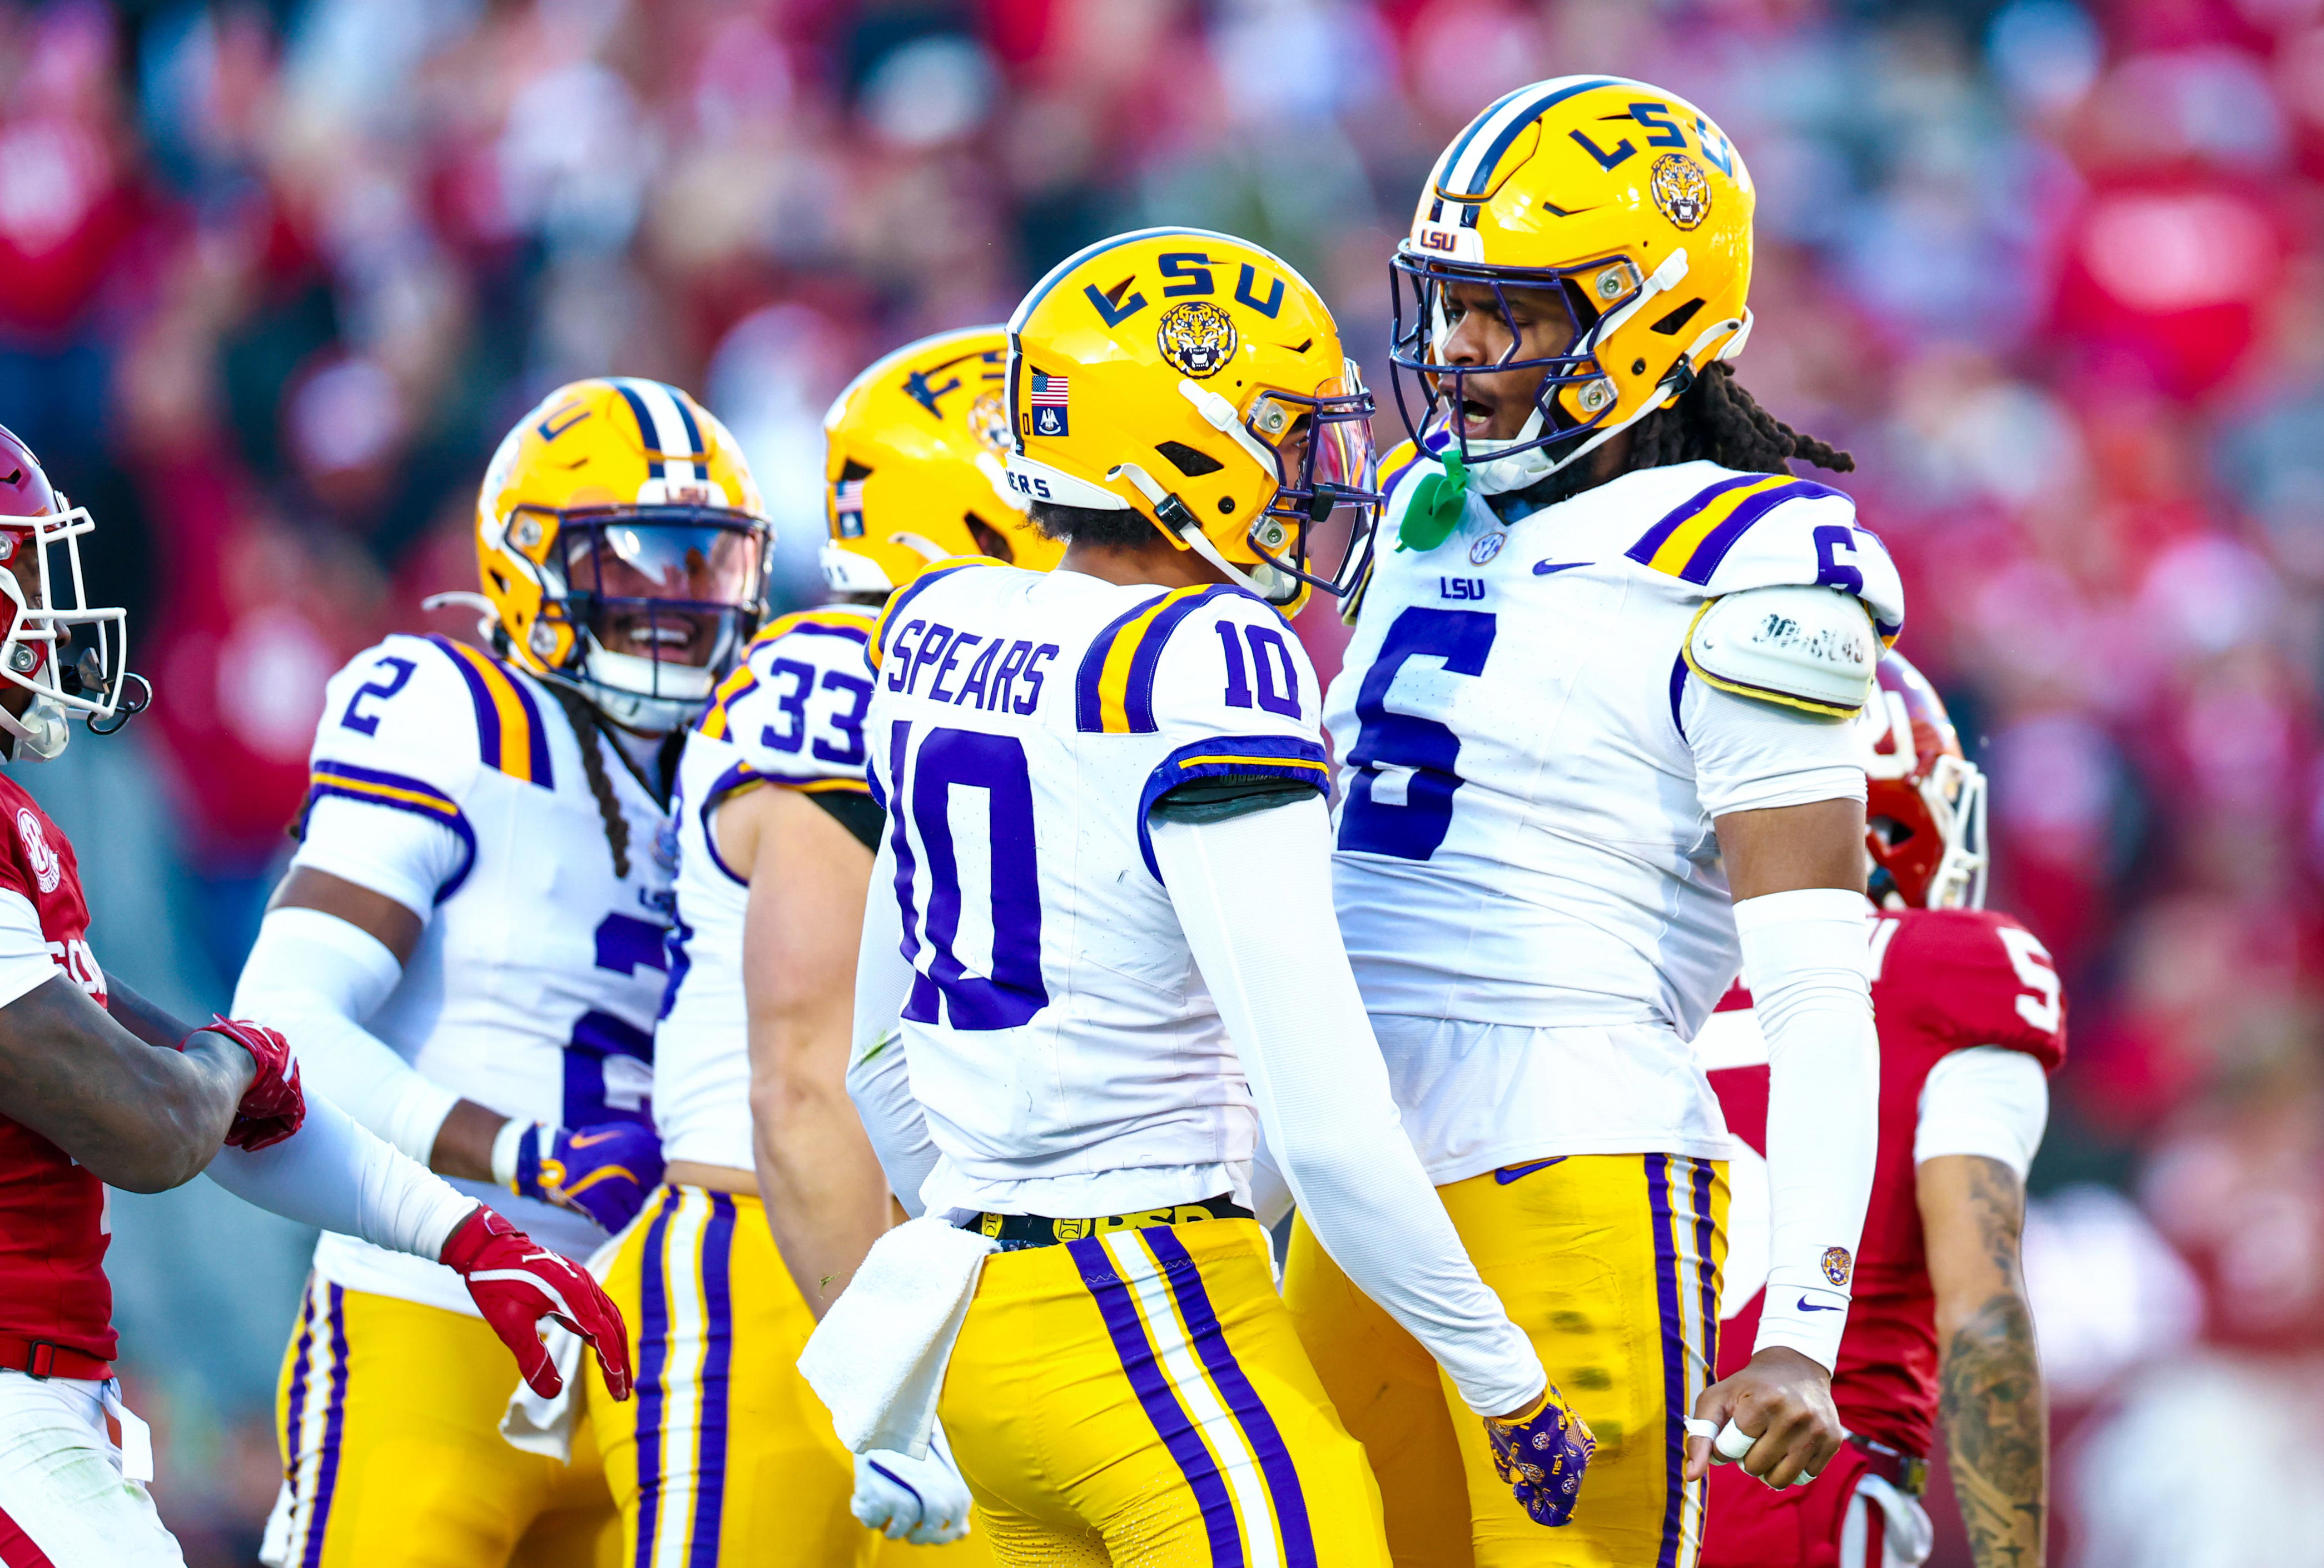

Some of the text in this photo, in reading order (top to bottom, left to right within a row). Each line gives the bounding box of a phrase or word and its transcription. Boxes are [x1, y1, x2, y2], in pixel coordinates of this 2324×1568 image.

[1569, 103, 1732, 178] LSU
[1420, 228, 1457, 252] LSU
[1084, 253, 1285, 328] LSU
[1006, 470, 1050, 498] ERS
[1441, 576, 1485, 600] LSU
[1813, 525, 1863, 595] 6
[341, 656, 418, 736] 2
[888, 620, 1059, 716] SPEARS
[1215, 620, 1302, 721] 10
[761, 658, 875, 766] 33
[1338, 606, 1496, 860] 6
[891, 720, 1049, 1031] 10
[1998, 927, 2062, 1033] 5
